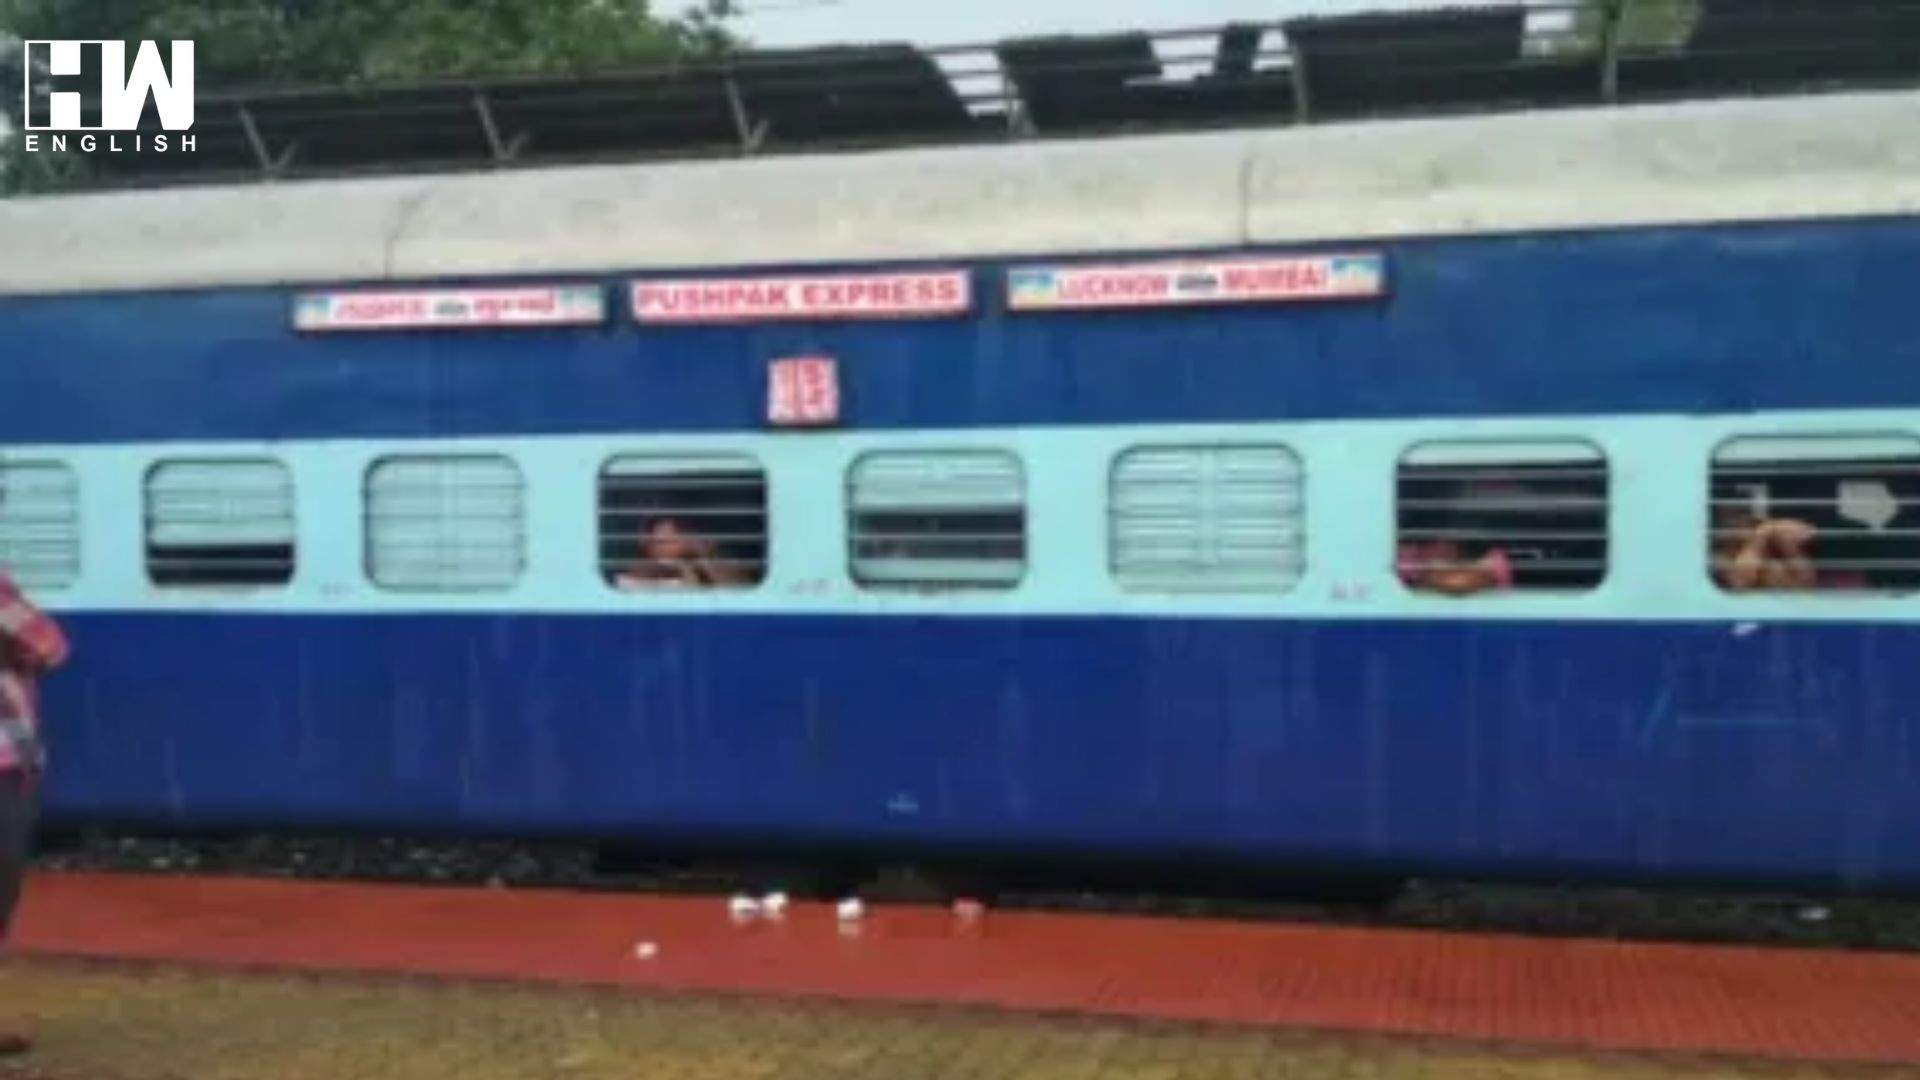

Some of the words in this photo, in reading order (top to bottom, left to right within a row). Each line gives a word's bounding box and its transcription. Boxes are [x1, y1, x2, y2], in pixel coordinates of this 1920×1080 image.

[1222, 263, 1329, 291] MUMBAI
[636, 284, 788, 310] PUSHPAK
[802, 278, 959, 307] EXPRESS
